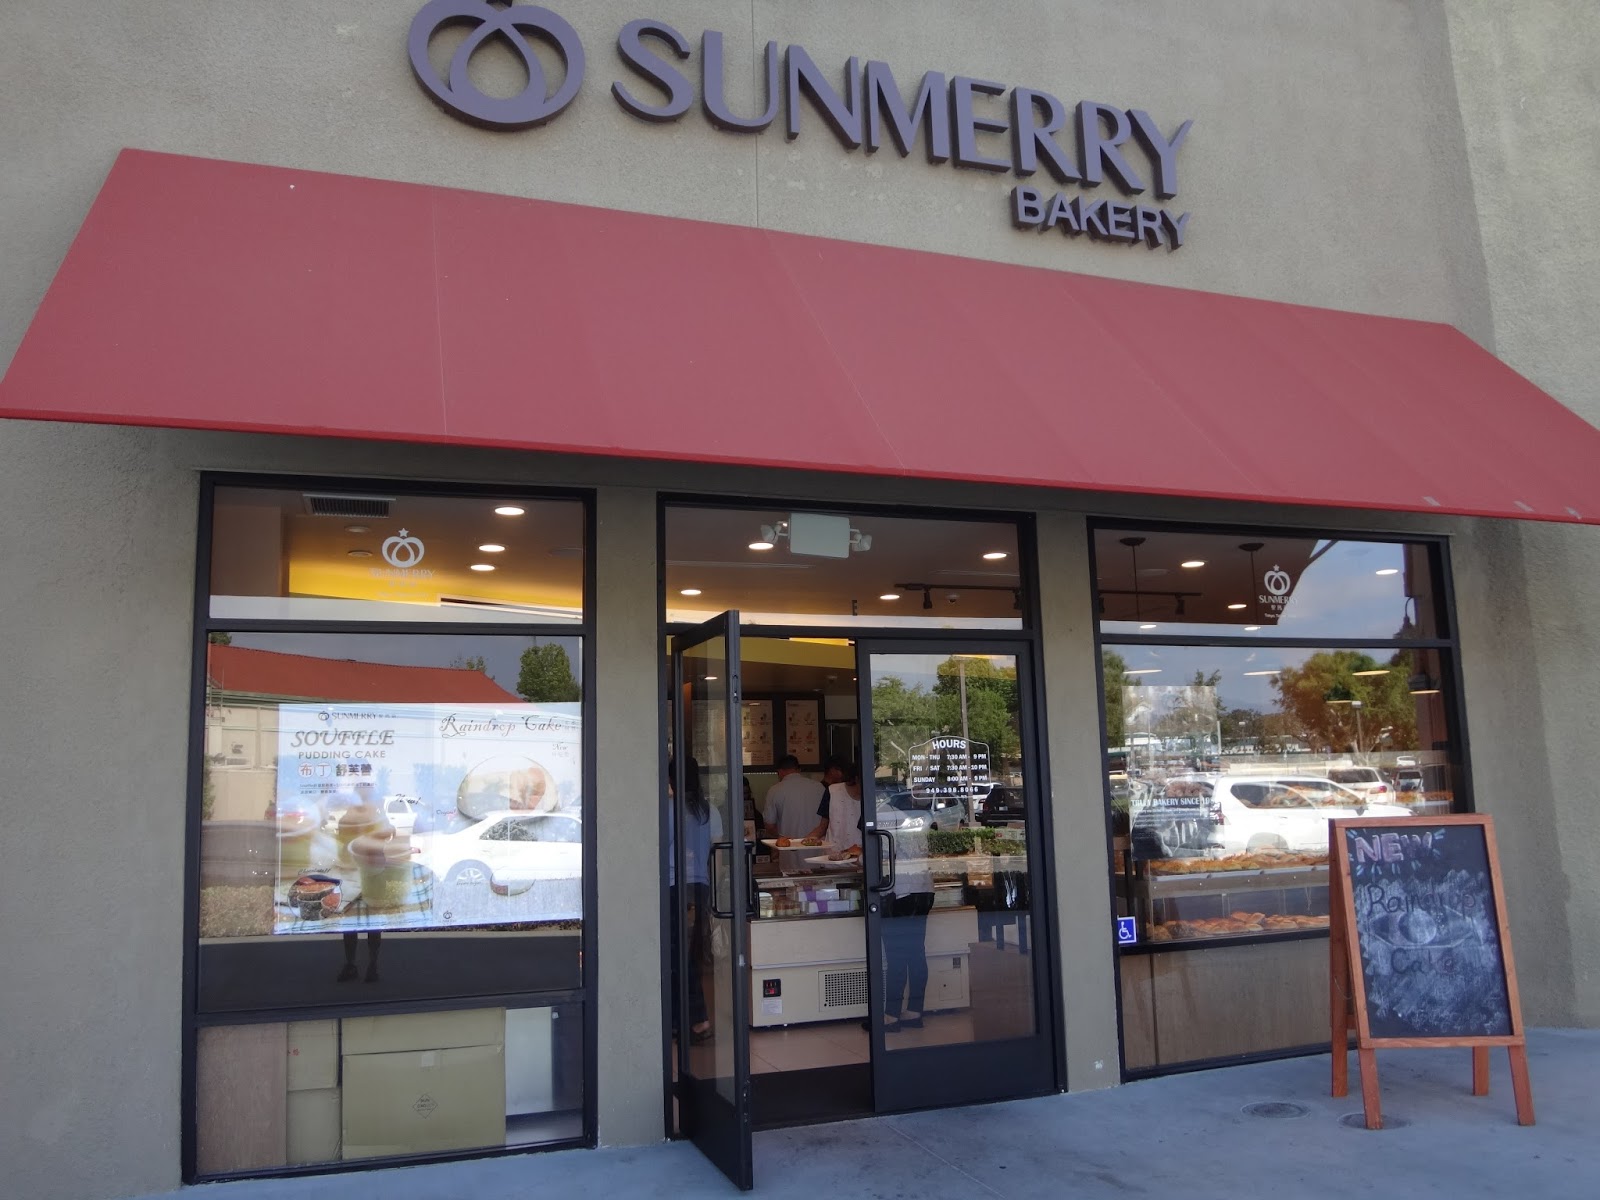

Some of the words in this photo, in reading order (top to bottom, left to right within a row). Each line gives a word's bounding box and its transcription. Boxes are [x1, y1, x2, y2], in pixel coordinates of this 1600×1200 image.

[611, 18, 1193, 200] SUNMERRY
[1011, 186, 1191, 251] BAKERY
[521, 715, 562, 732] Cake
[290, 728, 395, 748] SOUFFLE
[932, 739, 967, 750] HOURS
[298, 751, 351, 760] PUDDING
[355, 750, 386, 759] CAKE
[1153, 797, 1180, 806] BAKERY
[1180, 796, 1199, 805] SINCE
